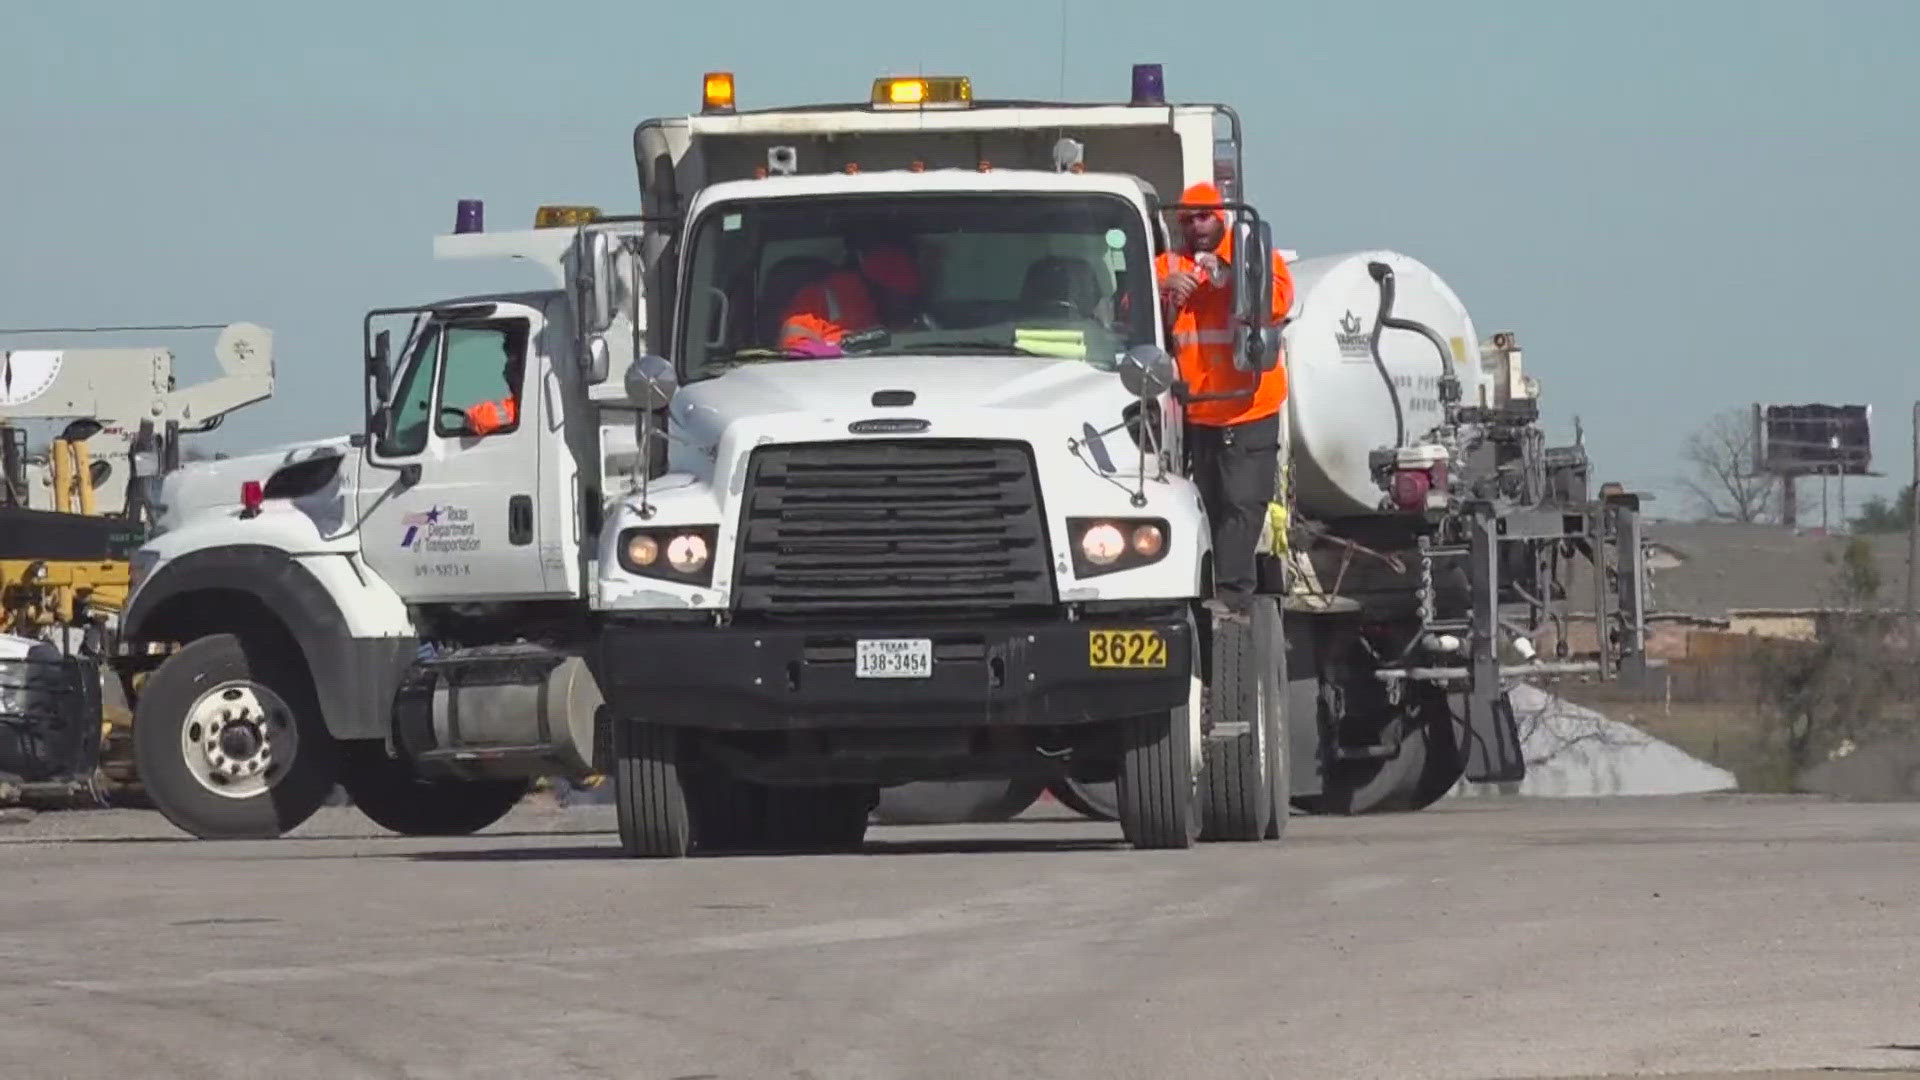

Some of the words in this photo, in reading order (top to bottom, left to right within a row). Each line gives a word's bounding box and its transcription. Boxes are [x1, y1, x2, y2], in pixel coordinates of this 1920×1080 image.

[443, 506, 468, 521] Texas
[428, 523, 475, 537] Department
[413, 539, 421, 553] of
[425, 537, 481, 552] Transportation
[880, 642, 909, 650] TEXAS
[1092, 633, 1164, 664] 3622
[862, 654, 927, 670] 138-3454
